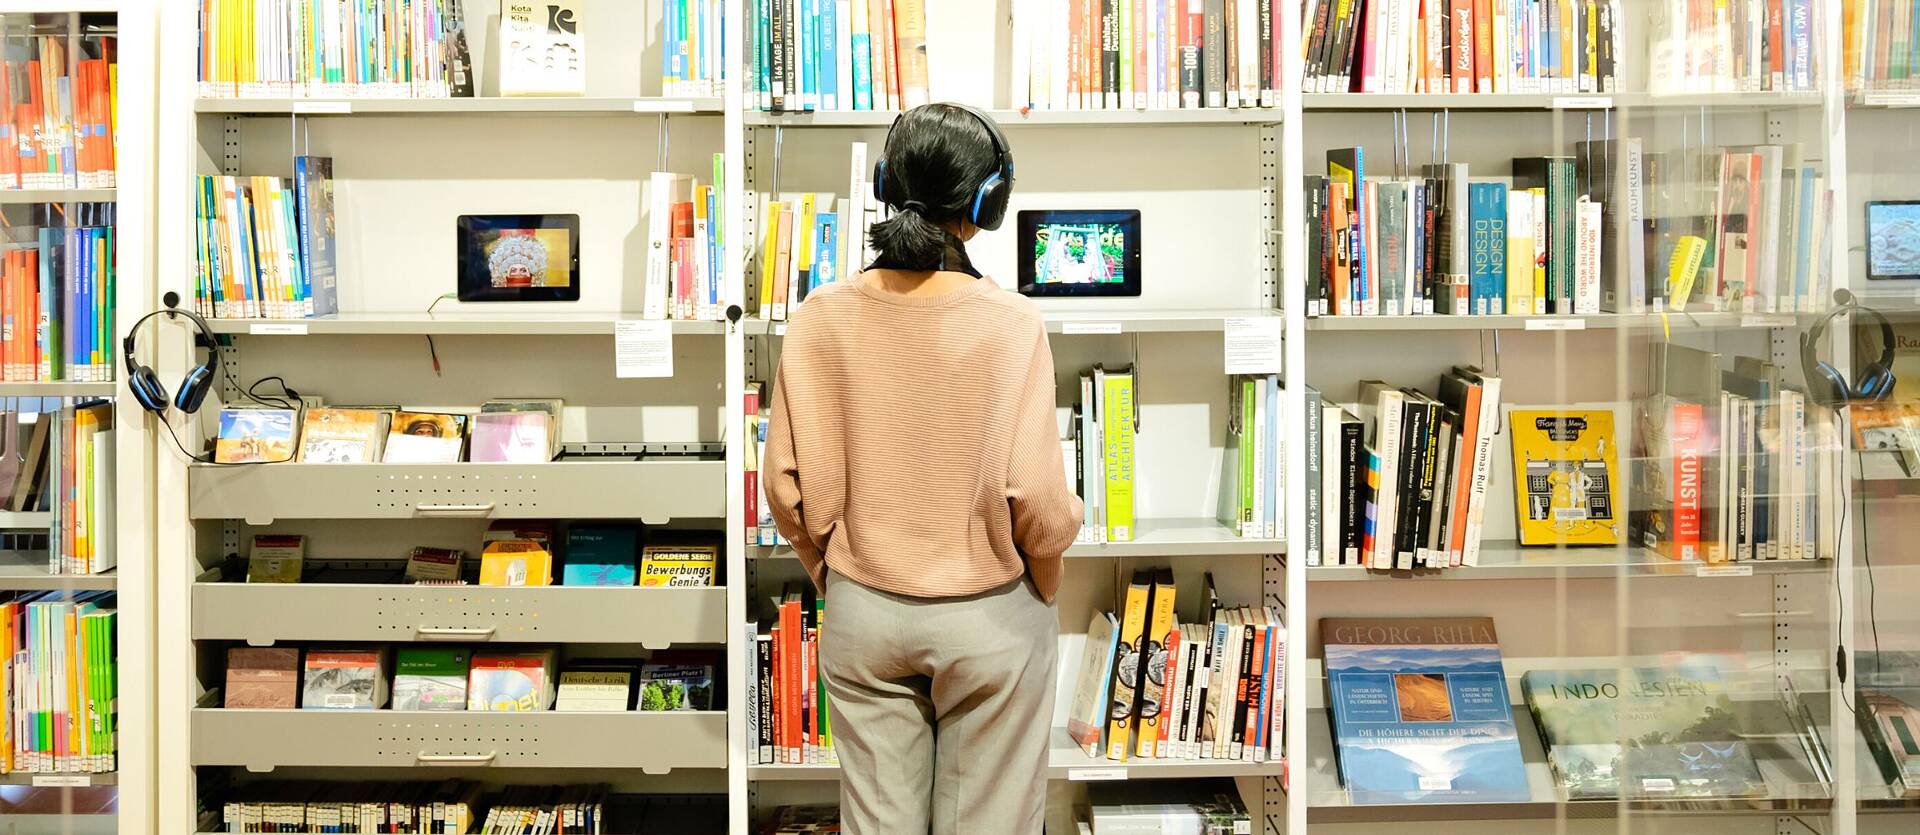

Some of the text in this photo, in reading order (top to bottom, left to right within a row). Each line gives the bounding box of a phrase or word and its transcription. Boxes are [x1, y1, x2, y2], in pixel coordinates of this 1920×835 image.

[1262, 13, 1270, 40] Harald
[1456, 8, 1470, 70] Kinderland
[774, 15, 782, 79] 166 TAGE IM ALL
[786, 47, 794, 70] Climate
[1184, 46, 1197, 70] 1000
[1476, 220, 1487, 274] DESIGN
[1491, 220, 1503, 273] DESIGN
[1121, 388, 1130, 480] ARCHITEKTUR
[1109, 443, 1117, 480] ATLAS
[1476, 437, 1489, 493] Thomas Ruff
[1680, 448, 1696, 510] KUNST
[646, 564, 711, 578] Bewerbungs
[669, 576, 710, 586] Genie 4
[1130, 600, 1139, 626] ALPHA
[1160, 598, 1168, 624] ALPHA
[1336, 625, 1492, 644] GEORG RIHA
[604, 676, 625, 684] Lyrik
[1274, 699, 1282, 717] KÖNIG
[1359, 728, 1374, 737] DIE
[1377, 727, 1413, 737] HÖHERE
[1418, 728, 1446, 736] SICHT
[1449, 728, 1466, 736] DER
